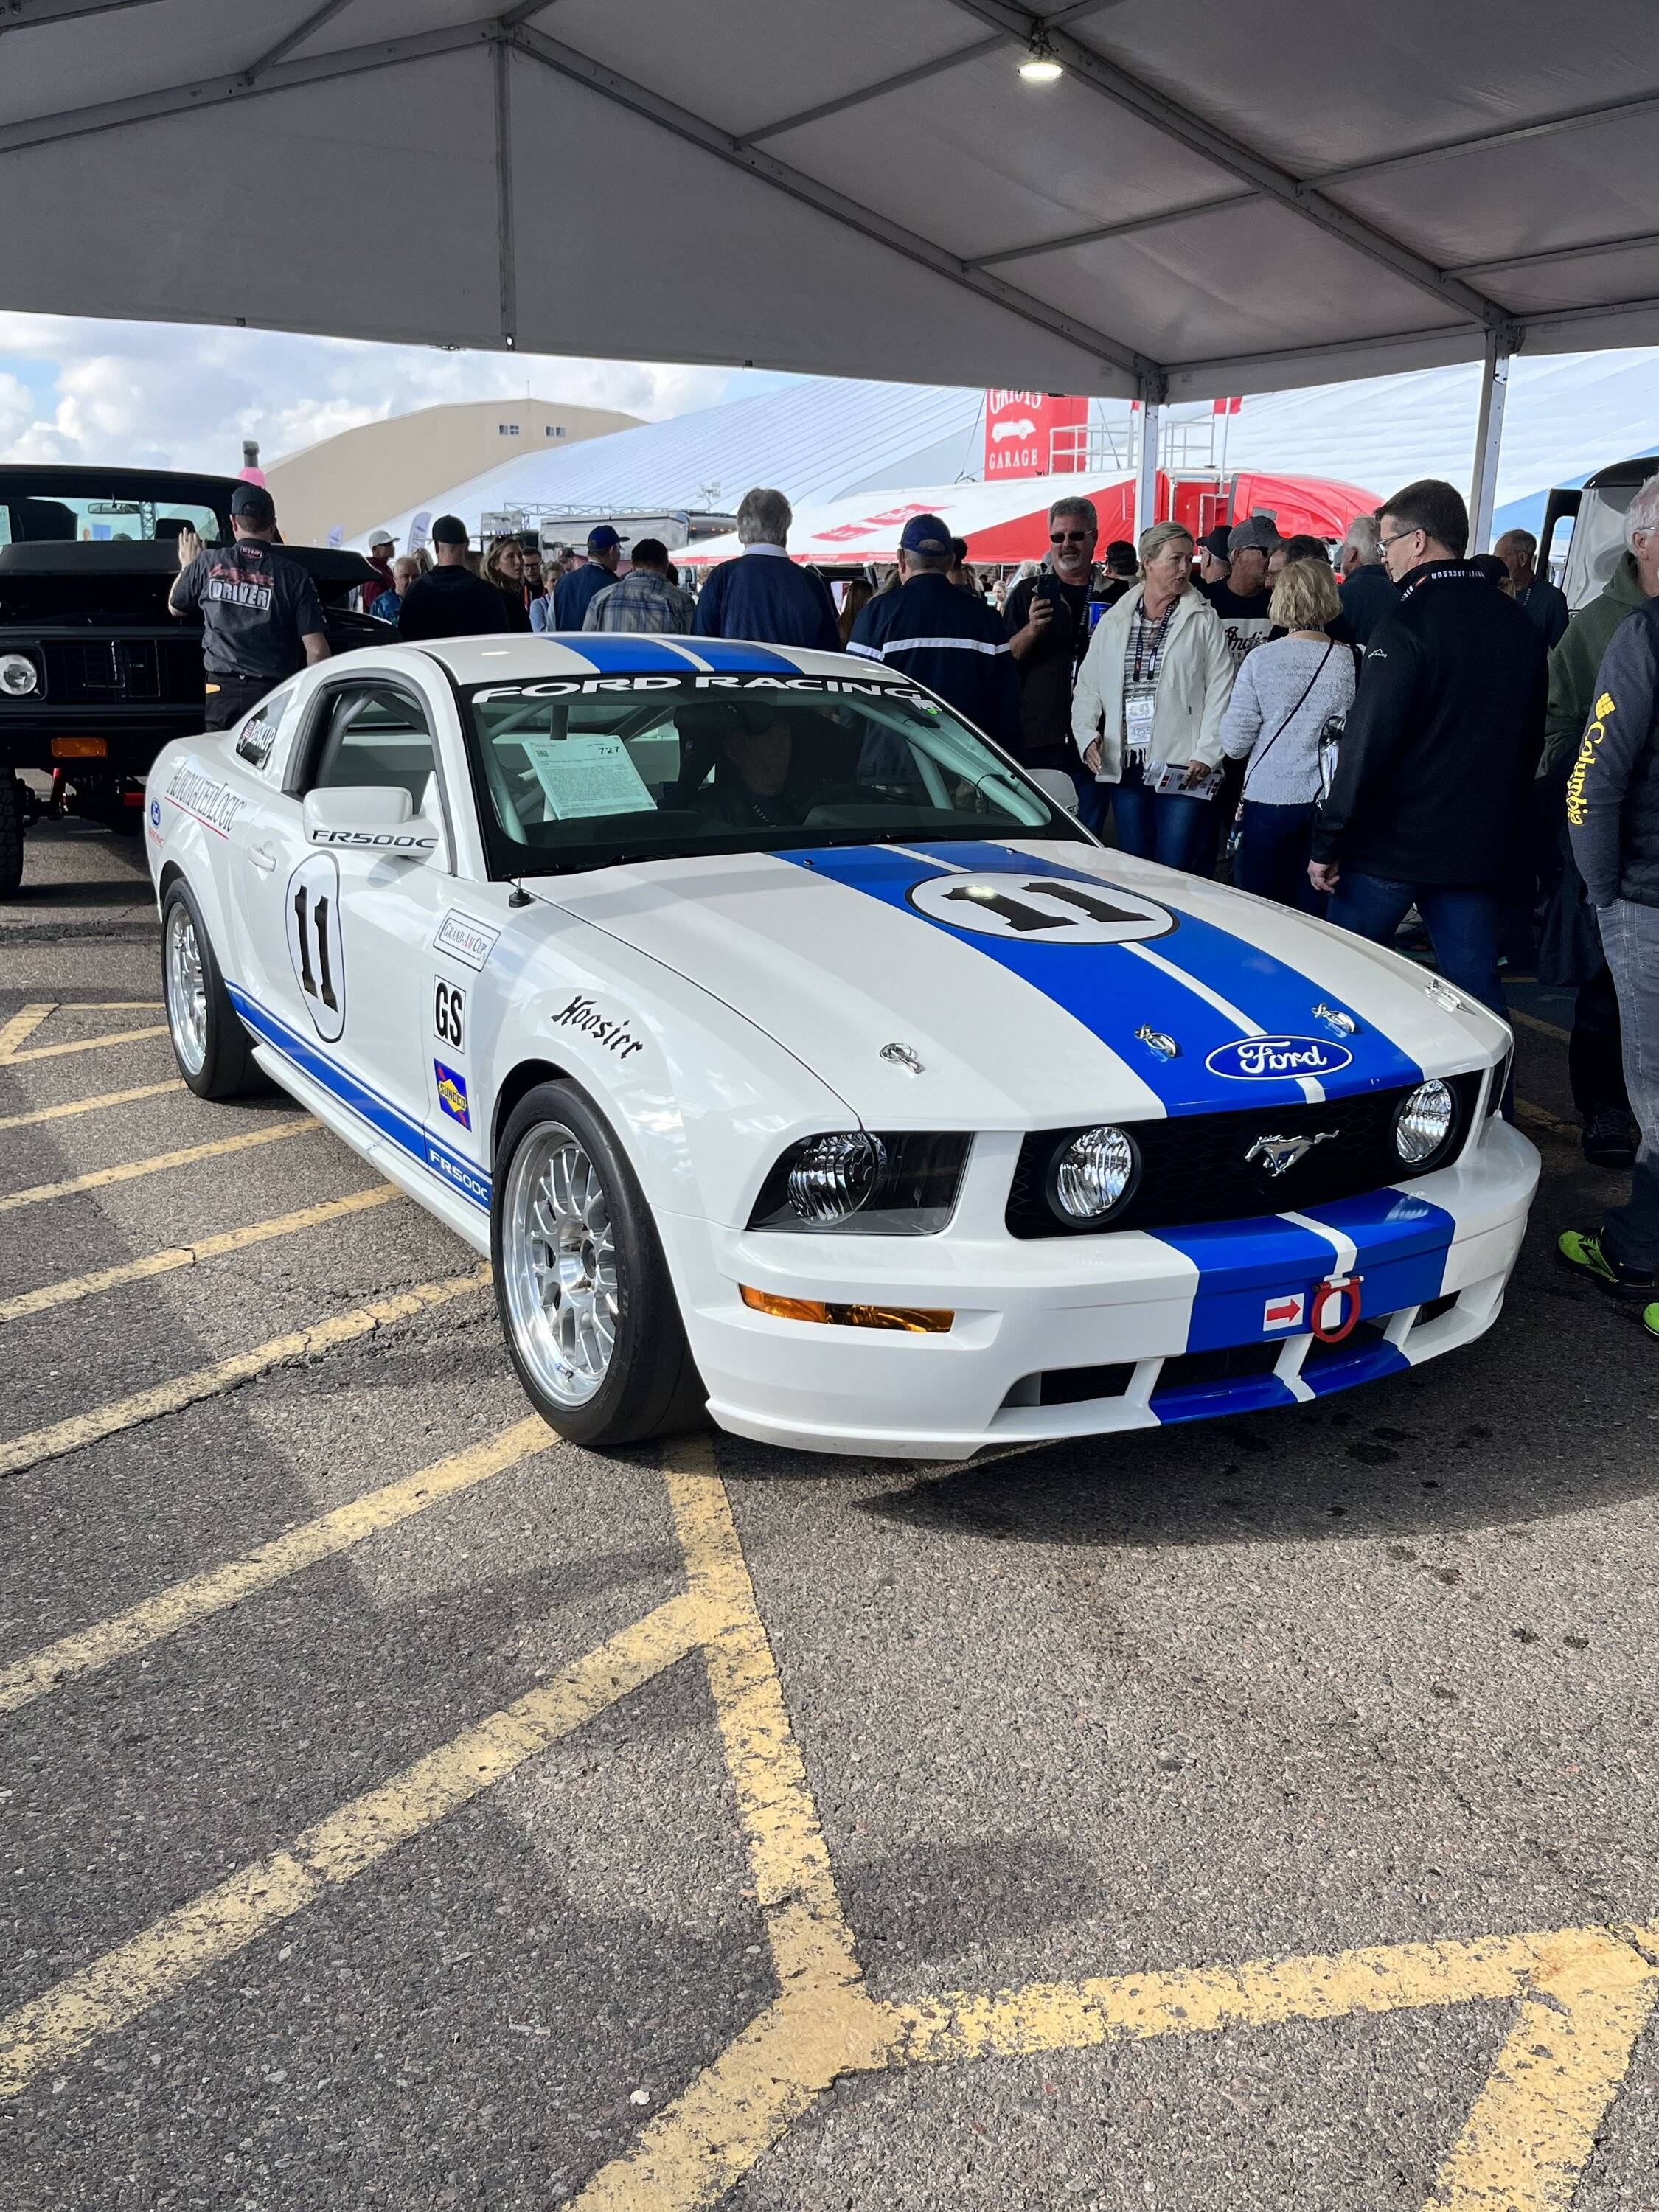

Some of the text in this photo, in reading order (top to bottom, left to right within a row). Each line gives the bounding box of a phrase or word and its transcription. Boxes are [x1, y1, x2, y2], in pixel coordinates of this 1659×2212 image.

[989, 448, 1038, 470] GARAGE
[212, 582, 268, 607] DRIVER
[472, 675, 921, 704] FORD RACING
[598, 745, 619, 755] 727
[1566, 721, 1605, 825] Columbia
[312, 830, 439, 849] FR500C
[940, 882, 1156, 932] 11
[294, 884, 338, 1013] 11
[436, 981, 463, 1047] GS
[551, 995, 644, 1060] Hoosier
[1237, 1040, 1327, 1074] Ford
[439, 1082, 466, 1110] SUNOCO
[429, 1147, 489, 1202] FR500C
